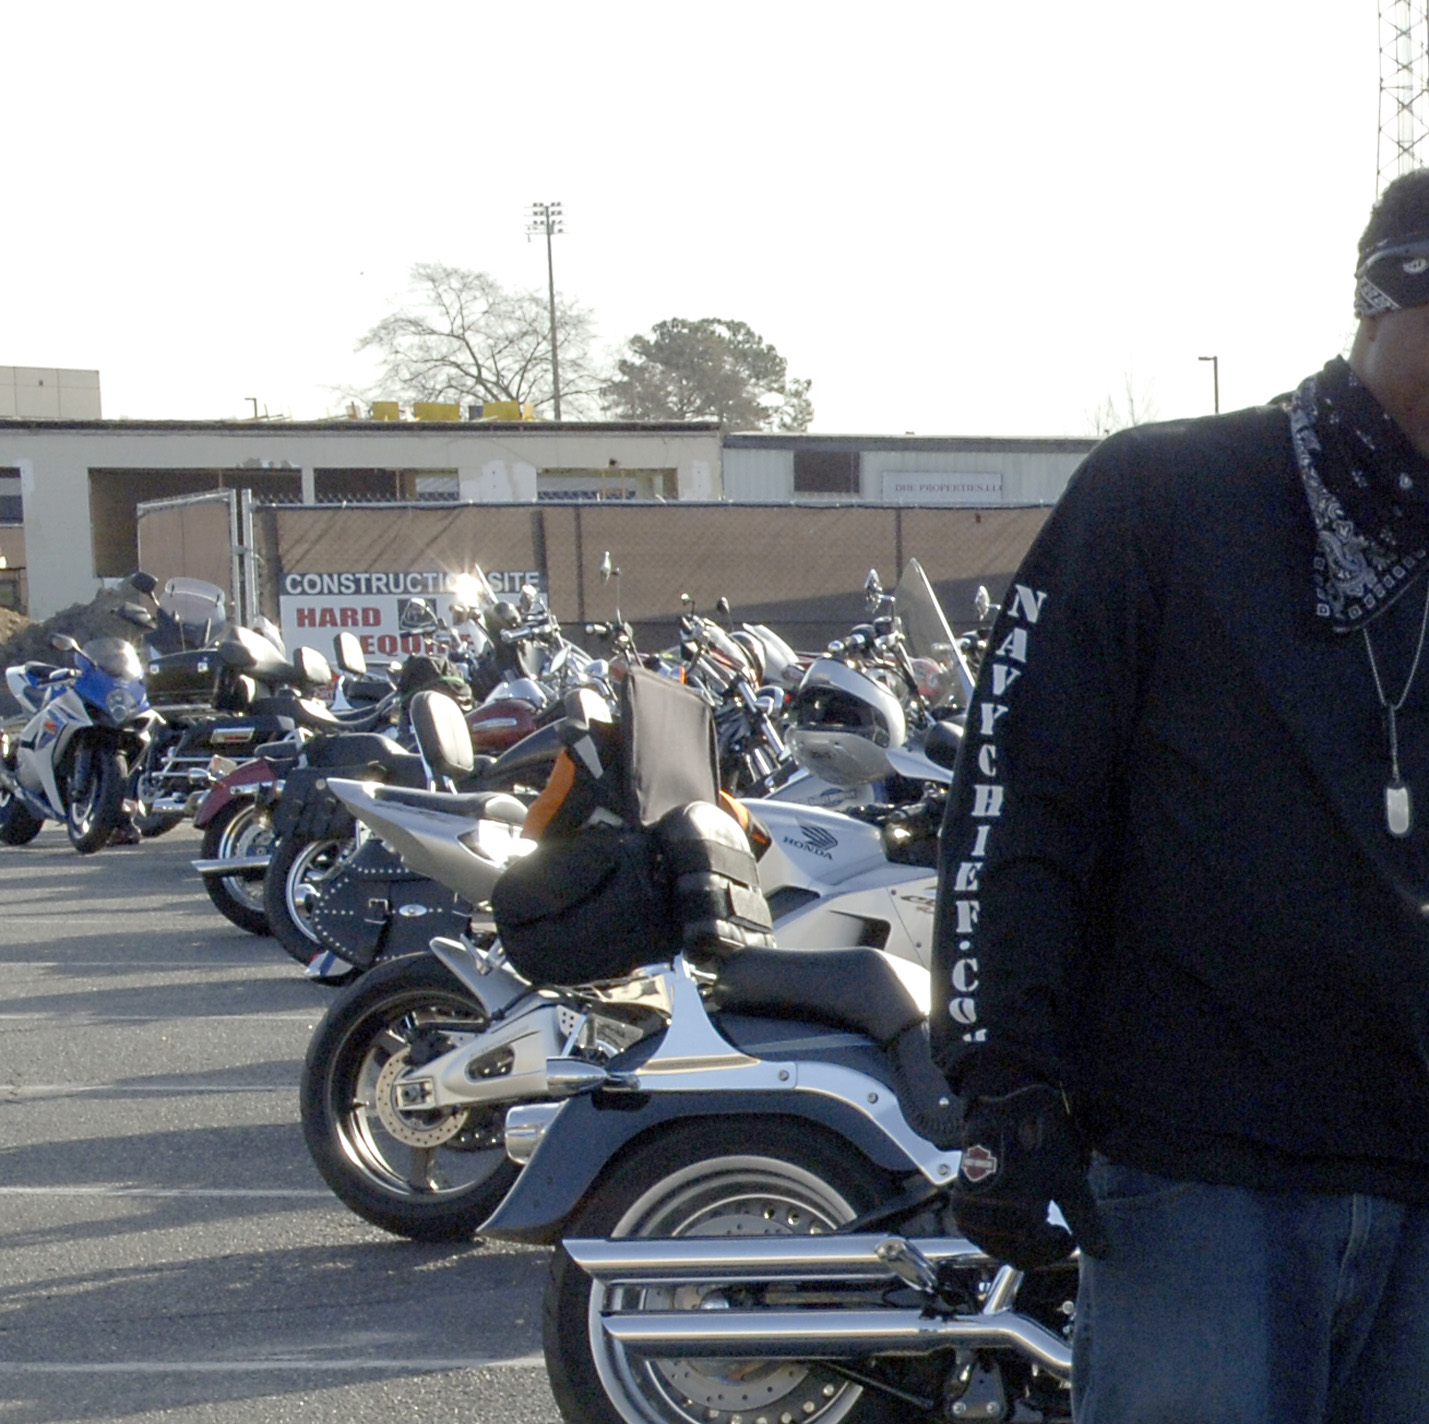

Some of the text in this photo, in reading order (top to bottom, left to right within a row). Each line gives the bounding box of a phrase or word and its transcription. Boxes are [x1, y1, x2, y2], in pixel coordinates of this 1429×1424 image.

[284, 571, 540, 595] CONSTRUCTI SITE
[296, 607, 382, 628] HARD
[783, 835, 833, 861] HONDA
